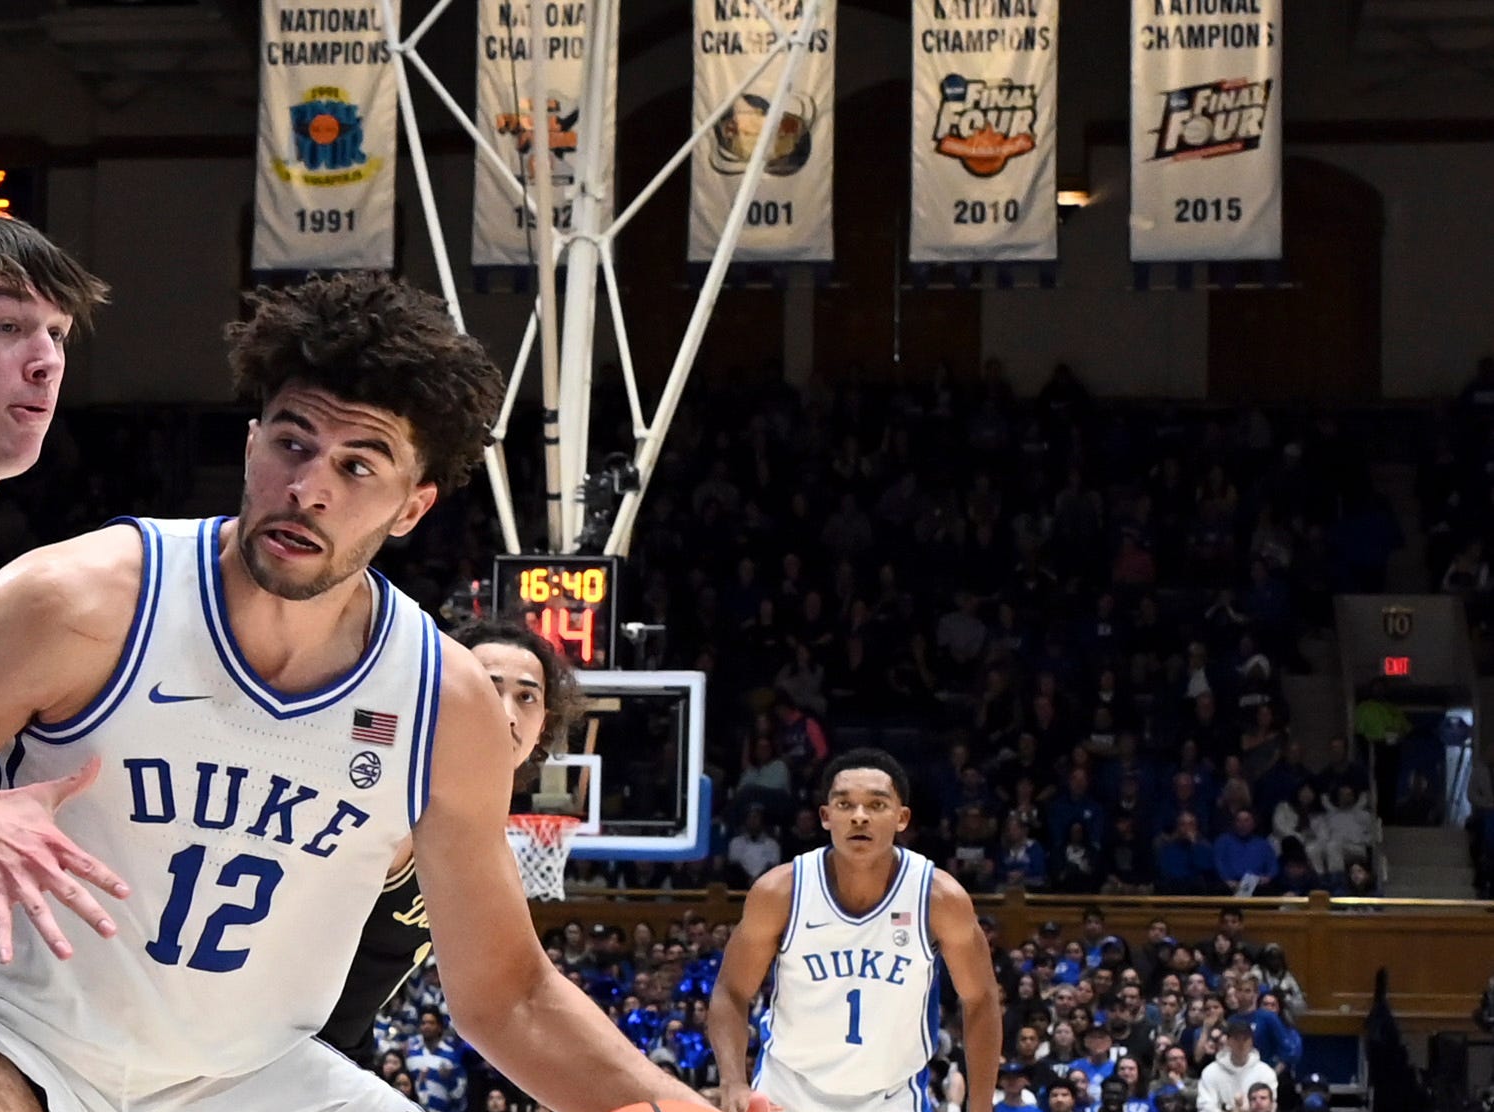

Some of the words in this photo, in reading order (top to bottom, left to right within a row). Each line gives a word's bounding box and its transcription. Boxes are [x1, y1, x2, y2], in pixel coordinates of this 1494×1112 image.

[280, 8, 381, 32] NATIONAL
[922, 26, 1050, 53] CHAMPIONS
[1141, 23, 1274, 49] CHAMPIONS
[267, 40, 392, 65] CHAMPIONS
[296, 208, 355, 233] 1991
[747, 201, 793, 225] 001
[953, 199, 1019, 224] 2010
[1175, 197, 1242, 222] 2015
[519, 567, 605, 602] 16:40
[123, 758, 370, 858] DUKE
[145, 844, 284, 973] 12
[802, 948, 912, 985] DUKE
[845, 989, 863, 1045] 1
